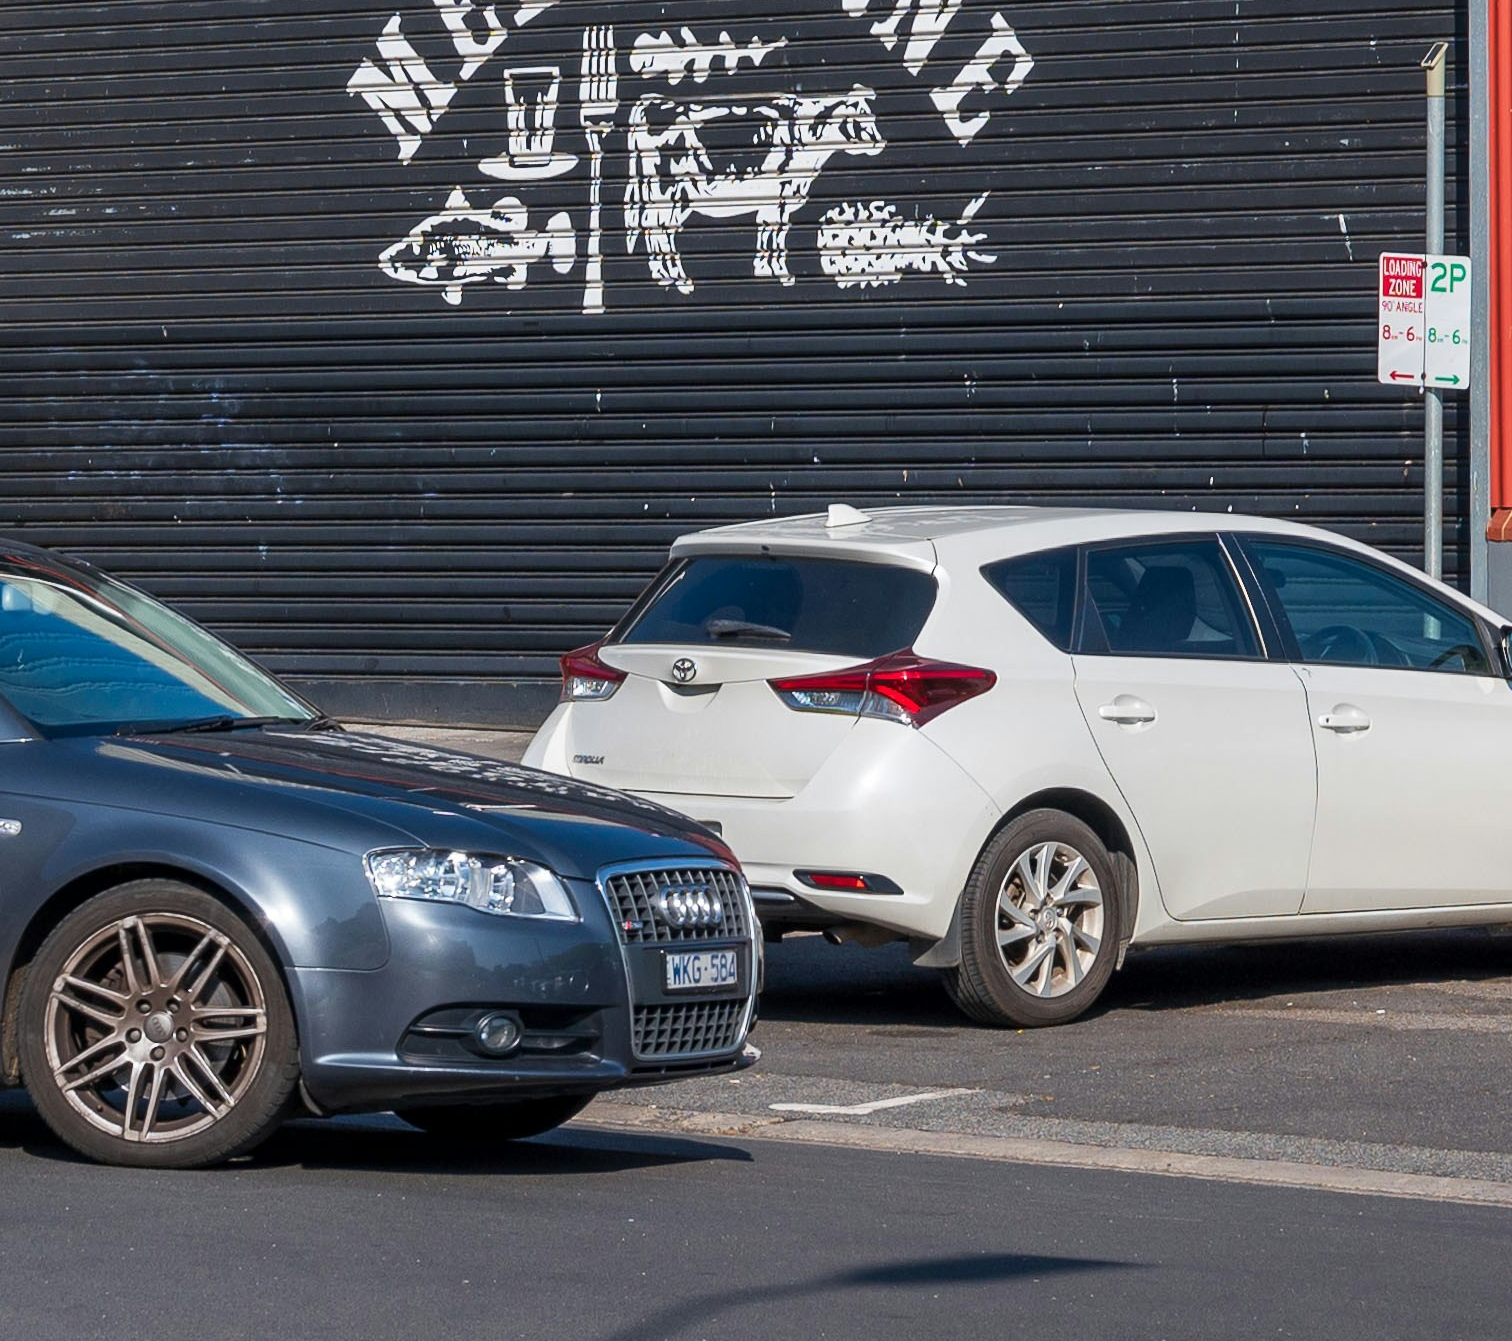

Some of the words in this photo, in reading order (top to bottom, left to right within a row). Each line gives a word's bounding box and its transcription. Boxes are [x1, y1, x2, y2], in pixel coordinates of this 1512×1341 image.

[1384, 259, 1422, 277] LOADING
[1430, 262, 1466, 293] 2P
[1388, 279, 1416, 296] ZONE
[1396, 301, 1423, 313] ANGLE
